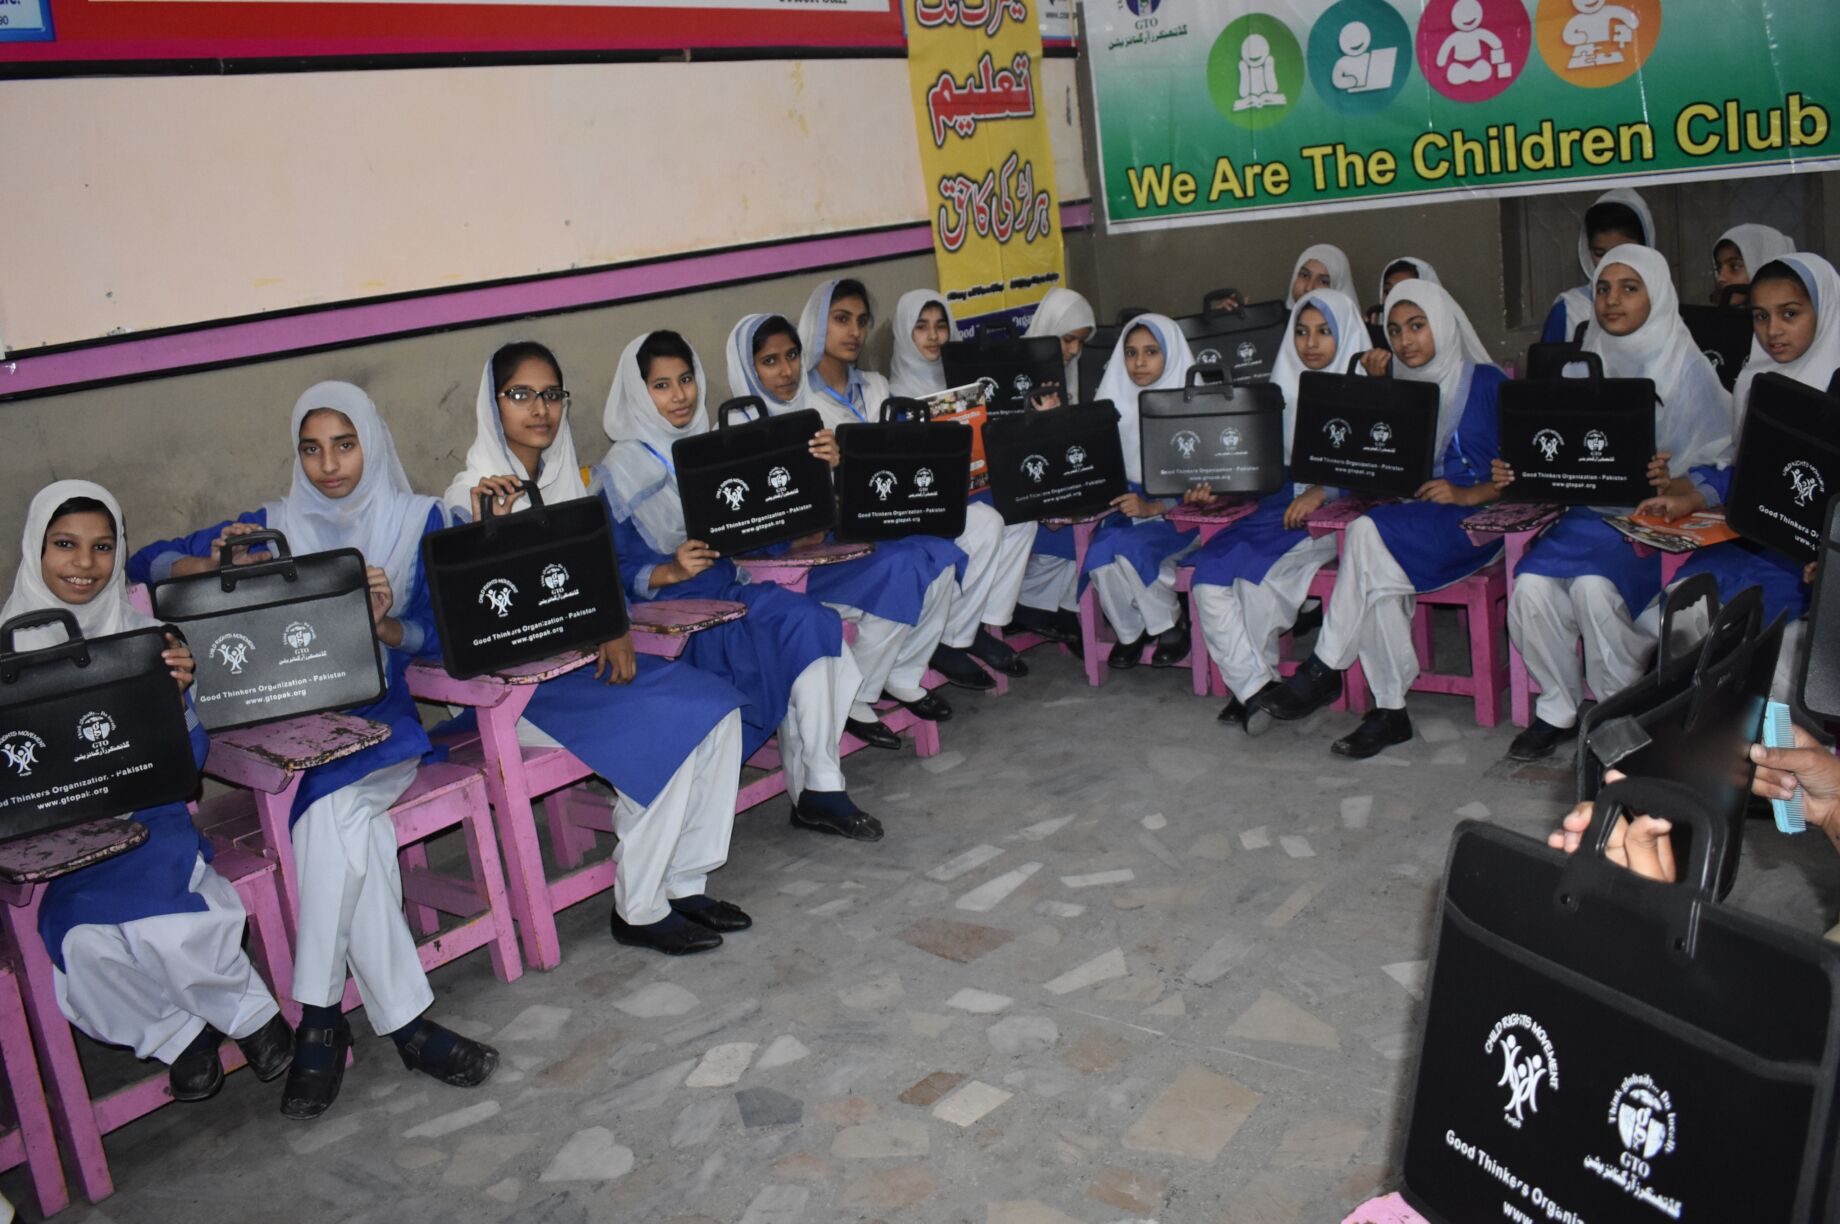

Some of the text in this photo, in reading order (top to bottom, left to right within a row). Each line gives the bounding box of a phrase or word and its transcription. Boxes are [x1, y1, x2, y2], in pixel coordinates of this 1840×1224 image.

[1134, 17, 1159, 31] GTO
[927, 51, 1035, 147] تعلیم
[1126, 92, 1831, 209] We Are The Children Club
[1759, 505, 1778, 518] Good
[473, 636, 492, 646] Good
[522, 616, 564, 633] Organization
[568, 606, 597, 619] Pakistan
[200, 691, 221, 703] Good
[222, 687, 257, 699] Thinkers
[258, 677, 307, 693] Organization
[313, 671, 346, 682] Pakistan
[245, 689, 307, 705] www.gtopak.org
[92, 739, 109, 749] GTO
[10, 789, 50, 805] Thinkers
[52, 773, 109, 794] Organization
[116, 762, 153, 777] Pakistan
[37, 785, 109, 810] www.gtopak.org
[1485, 1013, 1559, 1091] CHILD RIGHTS MOVEMENT
[1446, 1129, 1476, 1160] Good
[1477, 1149, 1530, 1197] Thinkers
[1620, 1151, 1650, 1178] GTO
